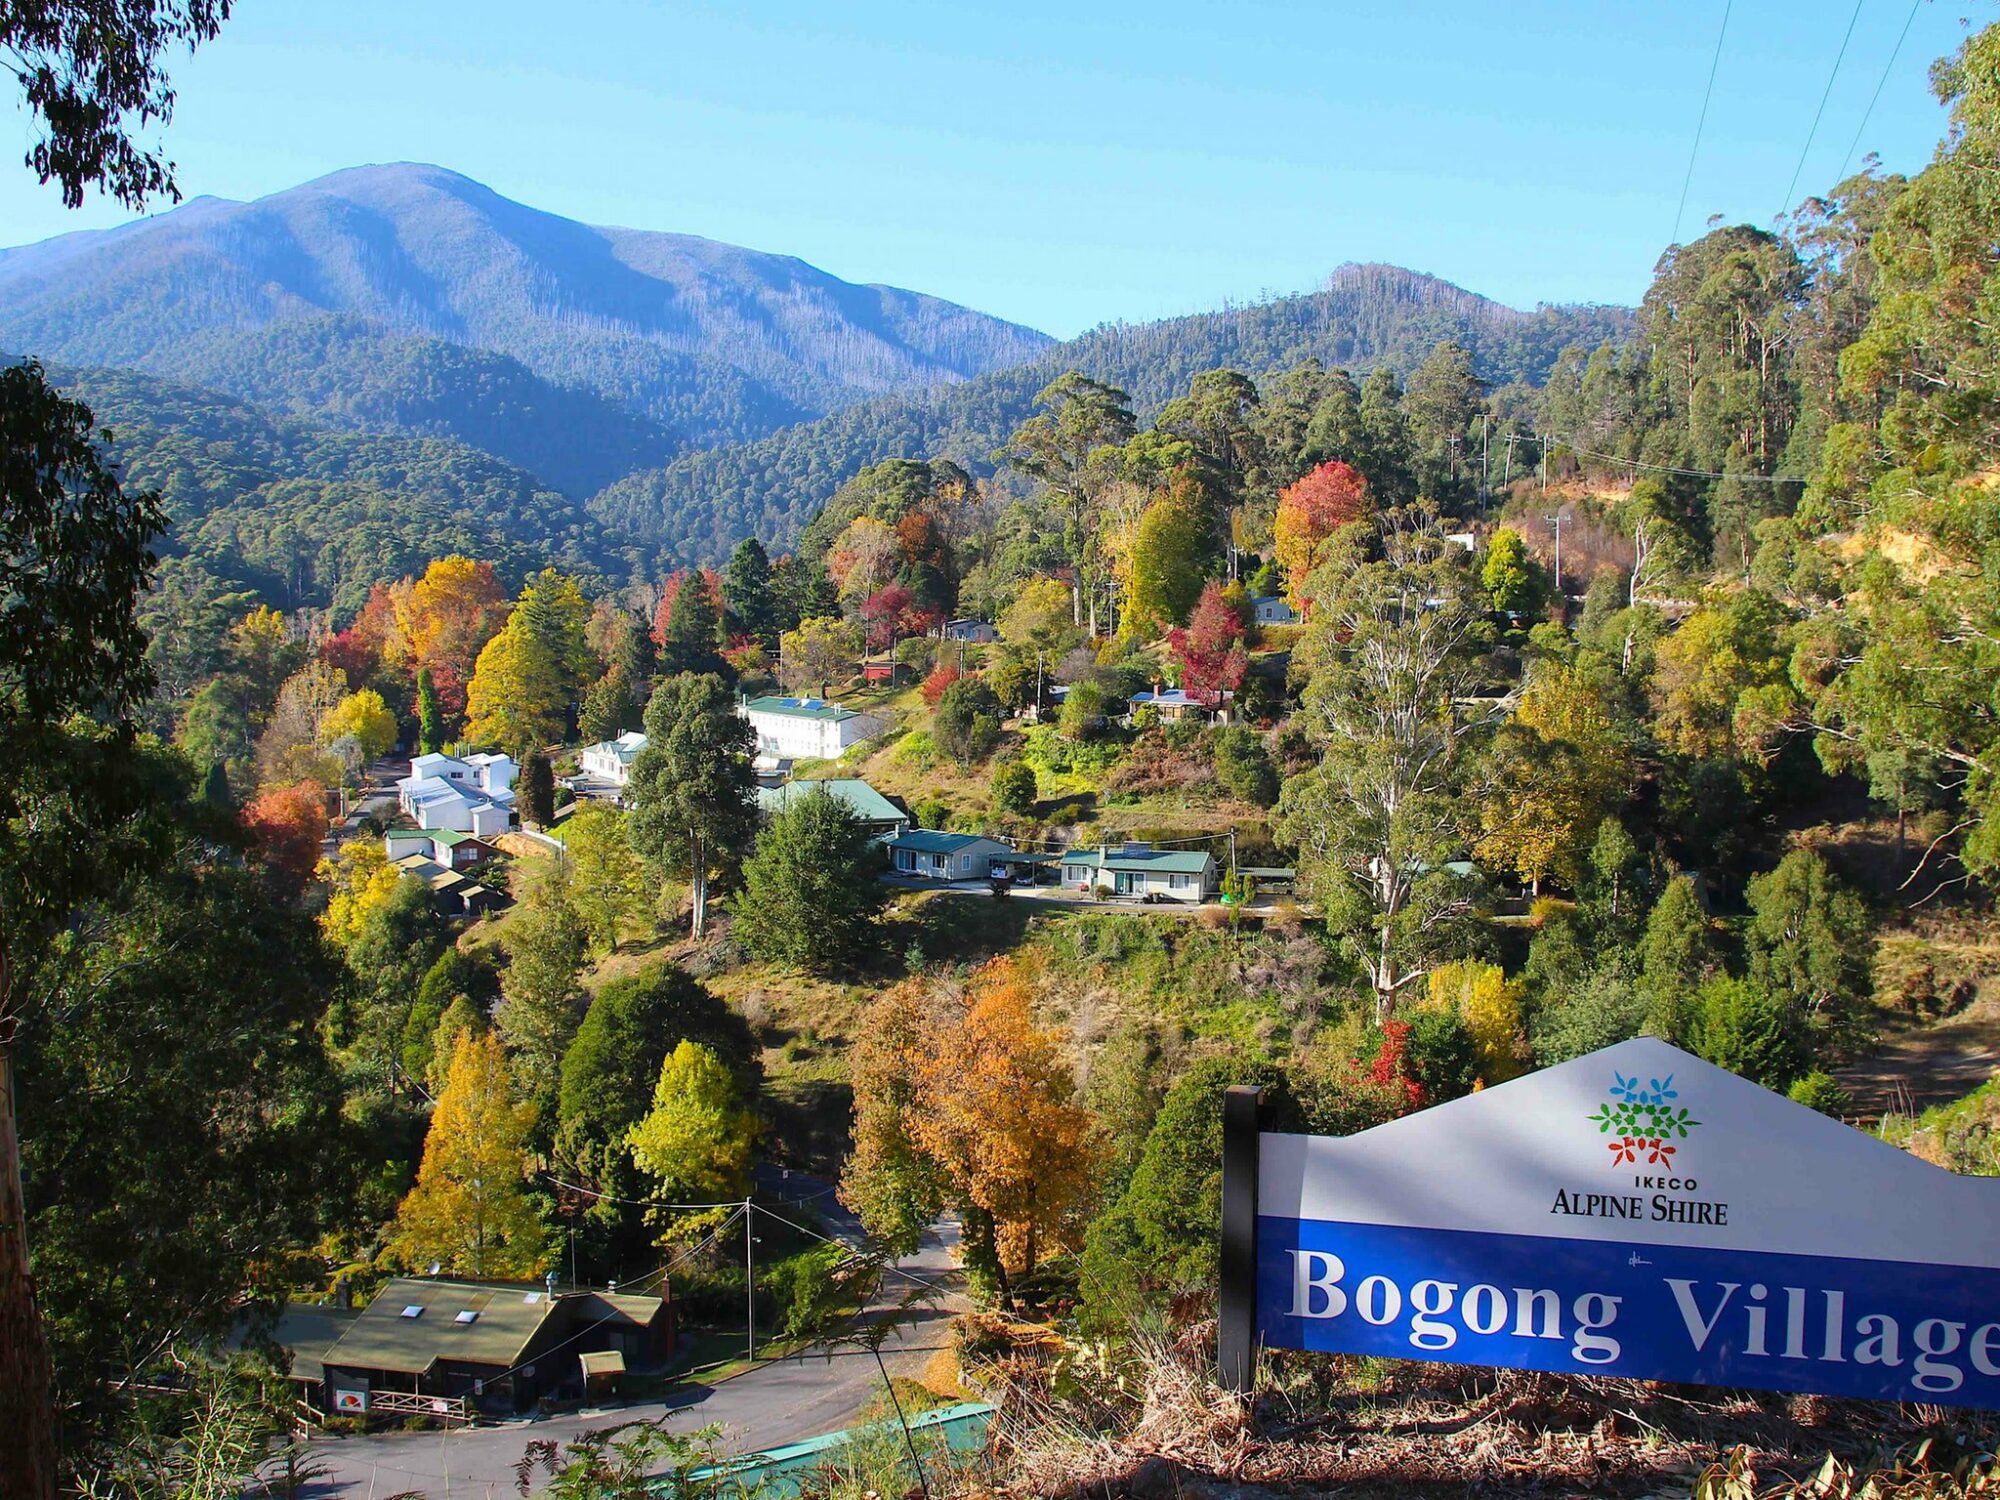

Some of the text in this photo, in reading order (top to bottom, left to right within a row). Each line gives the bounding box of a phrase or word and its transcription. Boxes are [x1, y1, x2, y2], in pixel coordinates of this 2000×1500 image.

[1635, 1175, 1697, 1191] IKECO
[1550, 1188, 1728, 1226] ALPINE SHIRE
[1283, 1248, 2000, 1393] Bogong Village
